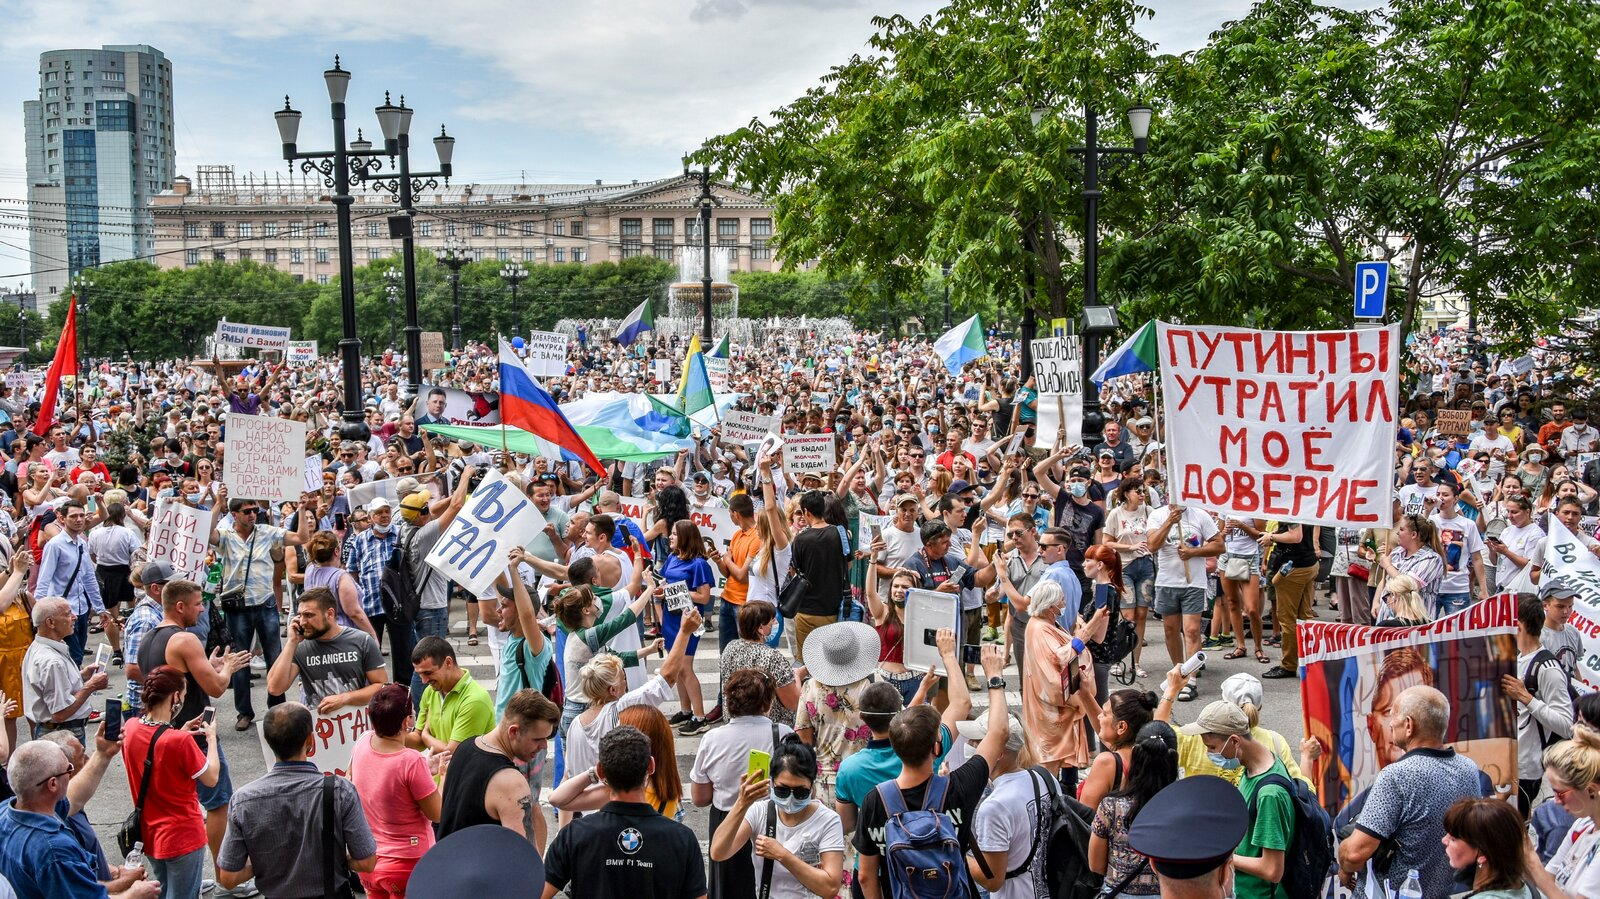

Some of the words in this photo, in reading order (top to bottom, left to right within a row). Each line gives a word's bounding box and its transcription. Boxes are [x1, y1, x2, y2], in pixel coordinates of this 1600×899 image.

[1361, 269, 1379, 309] P
[221, 324, 248, 335] Сергей
[251, 327, 287, 338] Иванович
[256, 338, 285, 347] Вами!
[532, 334, 566, 344] ХАБАРОВСК
[534, 343, 563, 351] АМУРКА
[1032, 341, 1059, 360] ПОШЕЛ
[1060, 337, 1078, 361] ВОН
[541, 352, 564, 361] ВАМИ
[1174, 374, 1392, 423] УТРАТИЛ
[451, 417, 470, 426] Руки
[740, 415, 755, 423] НЕТ
[1438, 411, 1469, 420] СВОБОДУ
[231, 417, 292, 433] ПРОСНИСЬ
[726, 421, 768, 433] МОСКОВСКИМ
[1437, 420, 1470, 431] ФУРГАЛУ!
[246, 431, 285, 444] НАРОД
[726, 430, 764, 440] ЗАСЛАНЦА
[231, 440, 291, 455] ПРОСНИСЬ
[801, 444, 827, 452] БЫДЛО!
[1219, 425, 1334, 472] МОЁ
[238, 452, 283, 464] СТРАНА
[801, 460, 828, 468] БУДЕМ!
[231, 463, 260, 474] ВЕДЬ
[268, 465, 297, 477] ВАМИ
[236, 474, 283, 486] ПРАВИТ
[236, 485, 283, 498] САТАНА
[1182, 464, 1379, 522] ДОВЕРИЕ
[307, 656, 320, 667] LOS
[322, 651, 358, 665] ANGELES
[636, 860, 653, 868] Team
